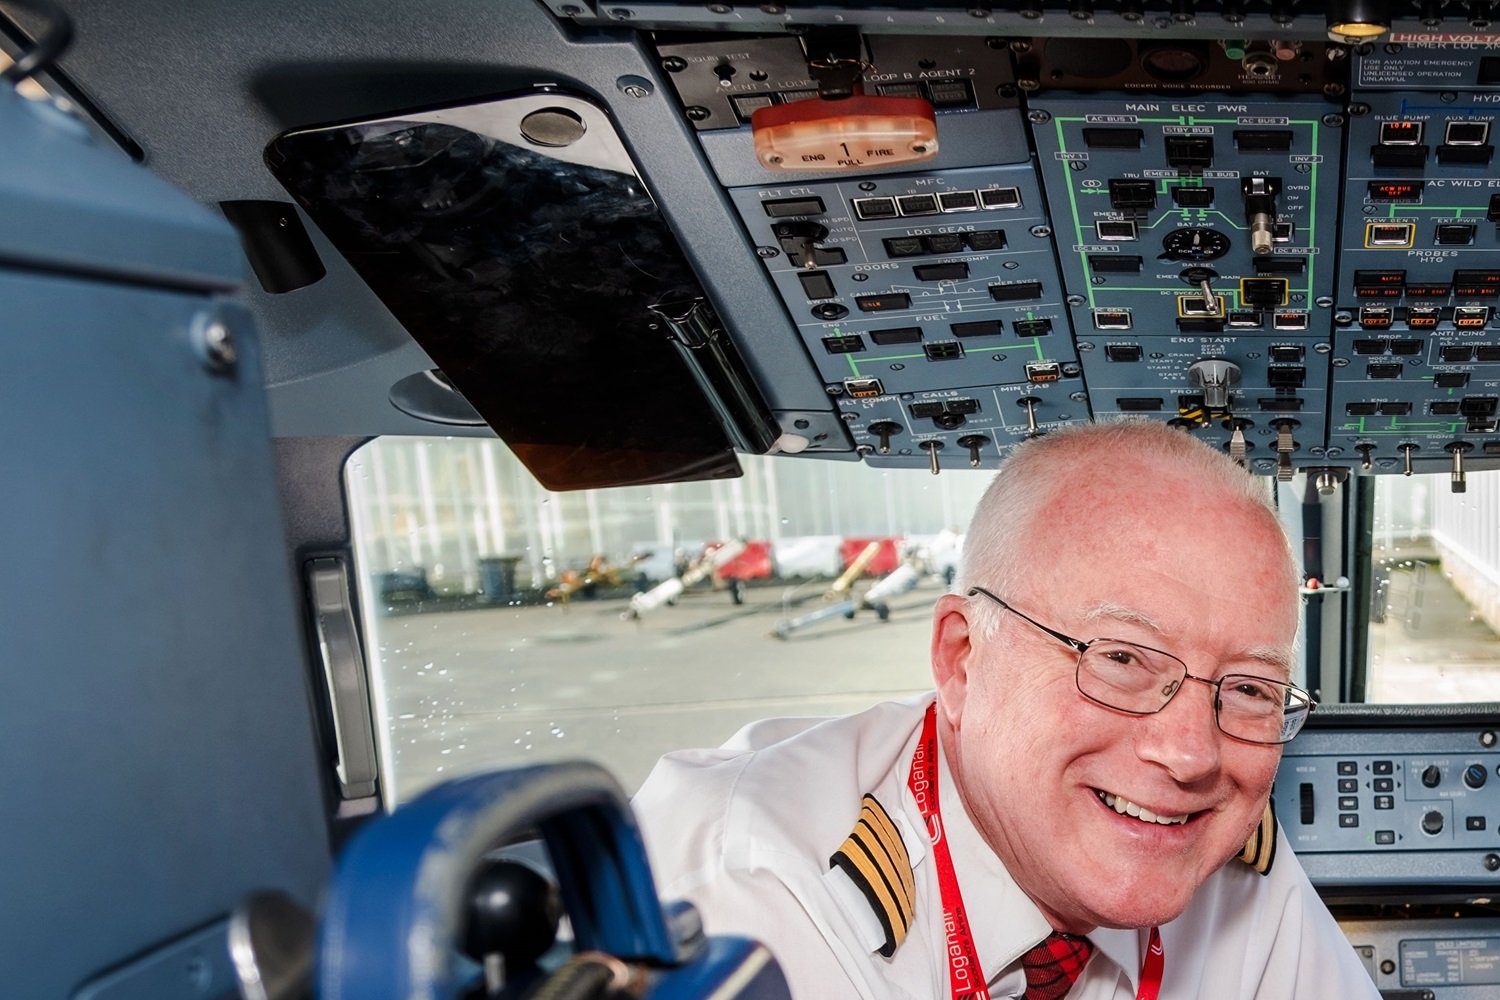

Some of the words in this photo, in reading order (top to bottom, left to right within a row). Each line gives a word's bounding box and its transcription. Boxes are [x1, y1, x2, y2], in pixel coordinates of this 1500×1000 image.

[1400, 34, 1443, 42] HIGH
[864, 74, 897, 82] LOOP
[920, 69, 962, 78] AGENT
[1473, 95, 1500, 103] HYD
[802, 153, 825, 162] ENG
[840, 142, 849, 156] 1
[915, 178, 945, 186] MFC
[759, 191, 782, 199] FLT
[938, 225, 975, 233] GEAR
[854, 263, 900, 271] DOORS
[916, 314, 948, 322] FUEL
[943, 908, 971, 992] Loganair
